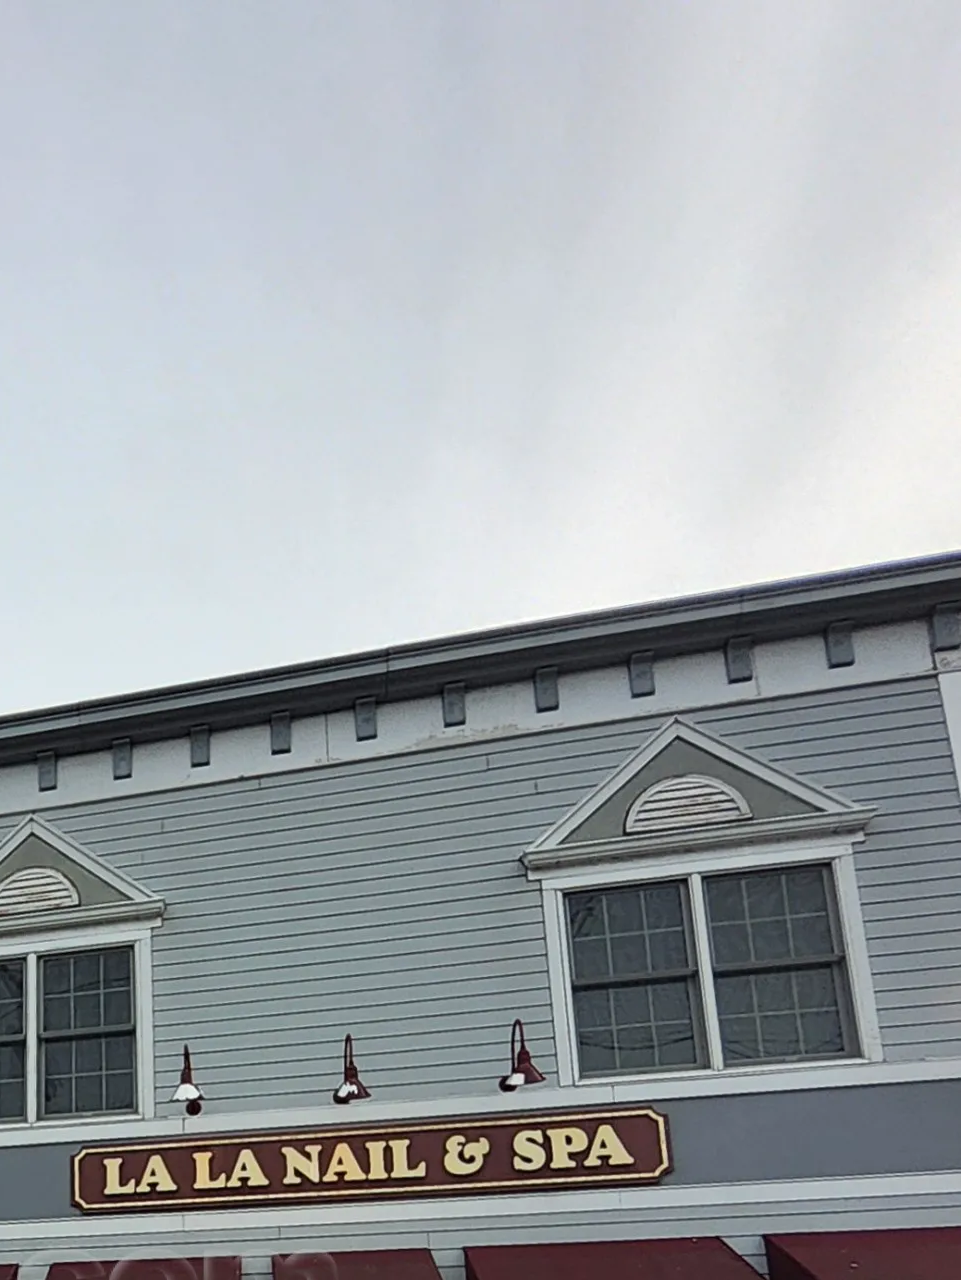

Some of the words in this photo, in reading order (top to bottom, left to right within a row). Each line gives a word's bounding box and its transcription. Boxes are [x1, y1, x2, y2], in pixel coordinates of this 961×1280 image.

[103, 1156, 178, 1195] LA
[192, 1149, 268, 1189] LA
[281, 1139, 426, 1184] NAIL
[443, 1135, 490, 1175] &
[512, 1124, 635, 1171] SPA
